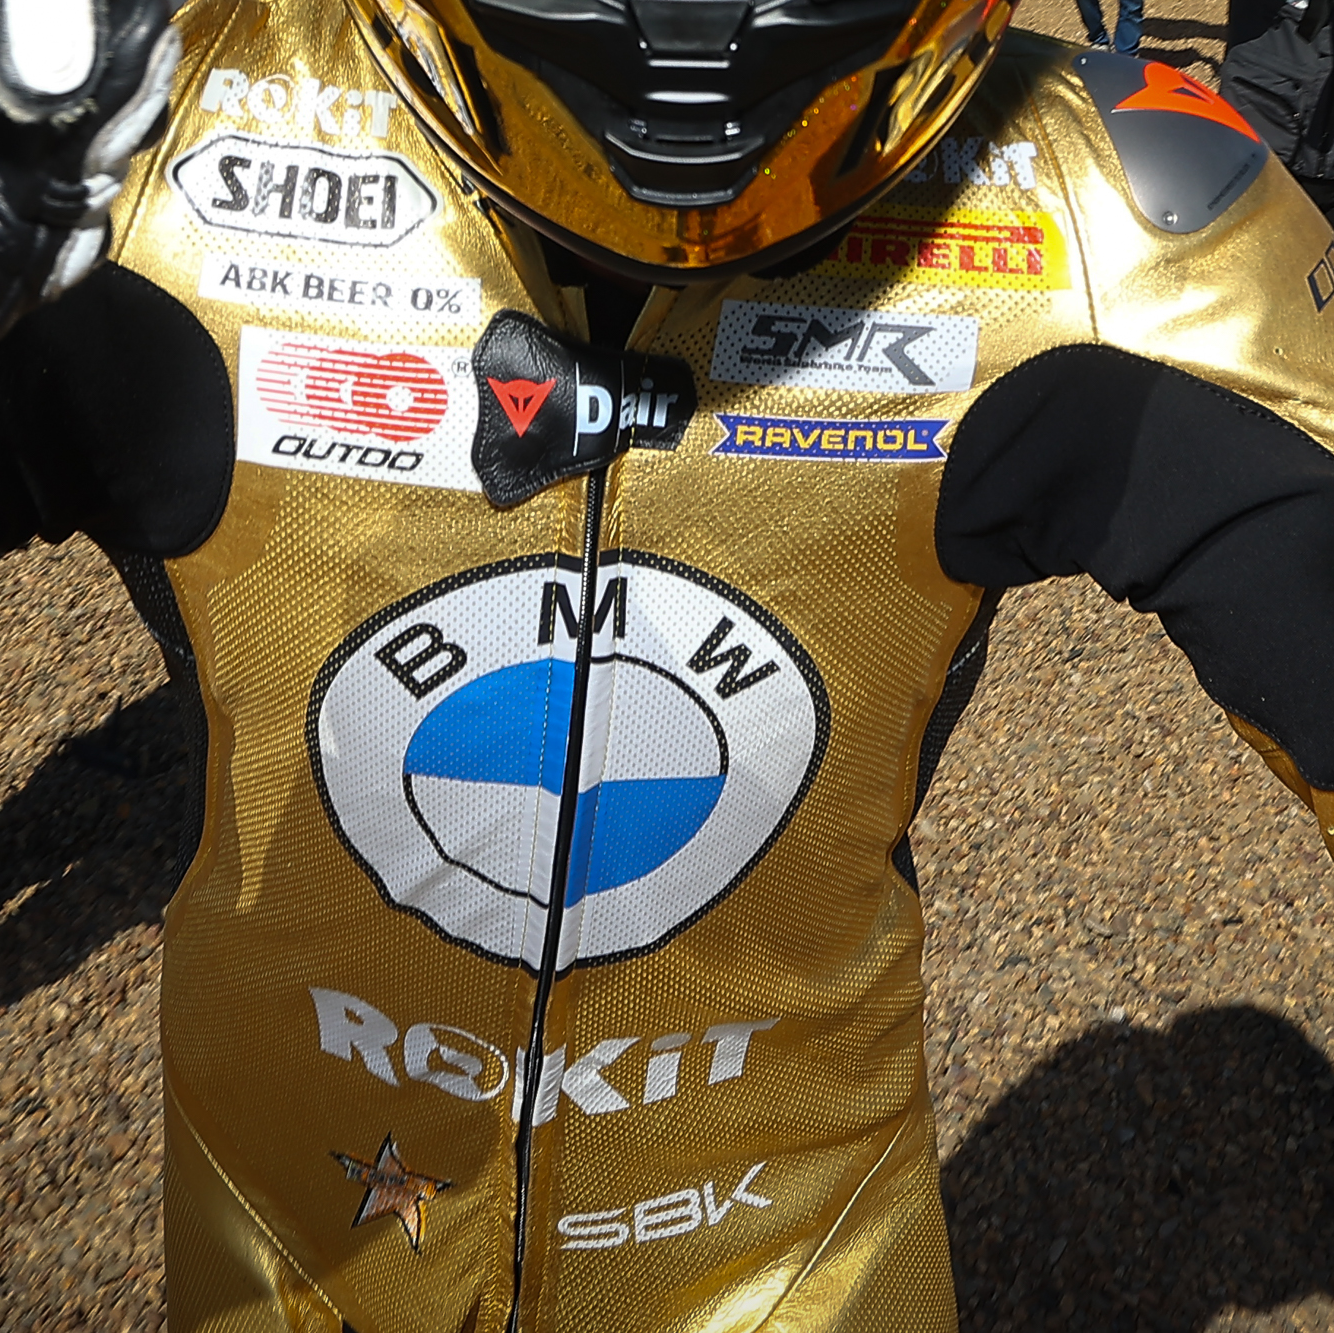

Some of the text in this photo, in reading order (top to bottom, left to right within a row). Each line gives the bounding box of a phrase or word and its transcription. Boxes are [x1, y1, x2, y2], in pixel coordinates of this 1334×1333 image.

[211, 154, 398, 230] SHOEI
[219, 263, 463, 315] ABK BEER 0%
[740, 314, 937, 387] SMR
[271, 434, 424, 473] OUTDO
[735, 424, 929, 452] RAVENOL
[373, 577, 781, 702] BMW
[557, 1161, 774, 1250] SBK
